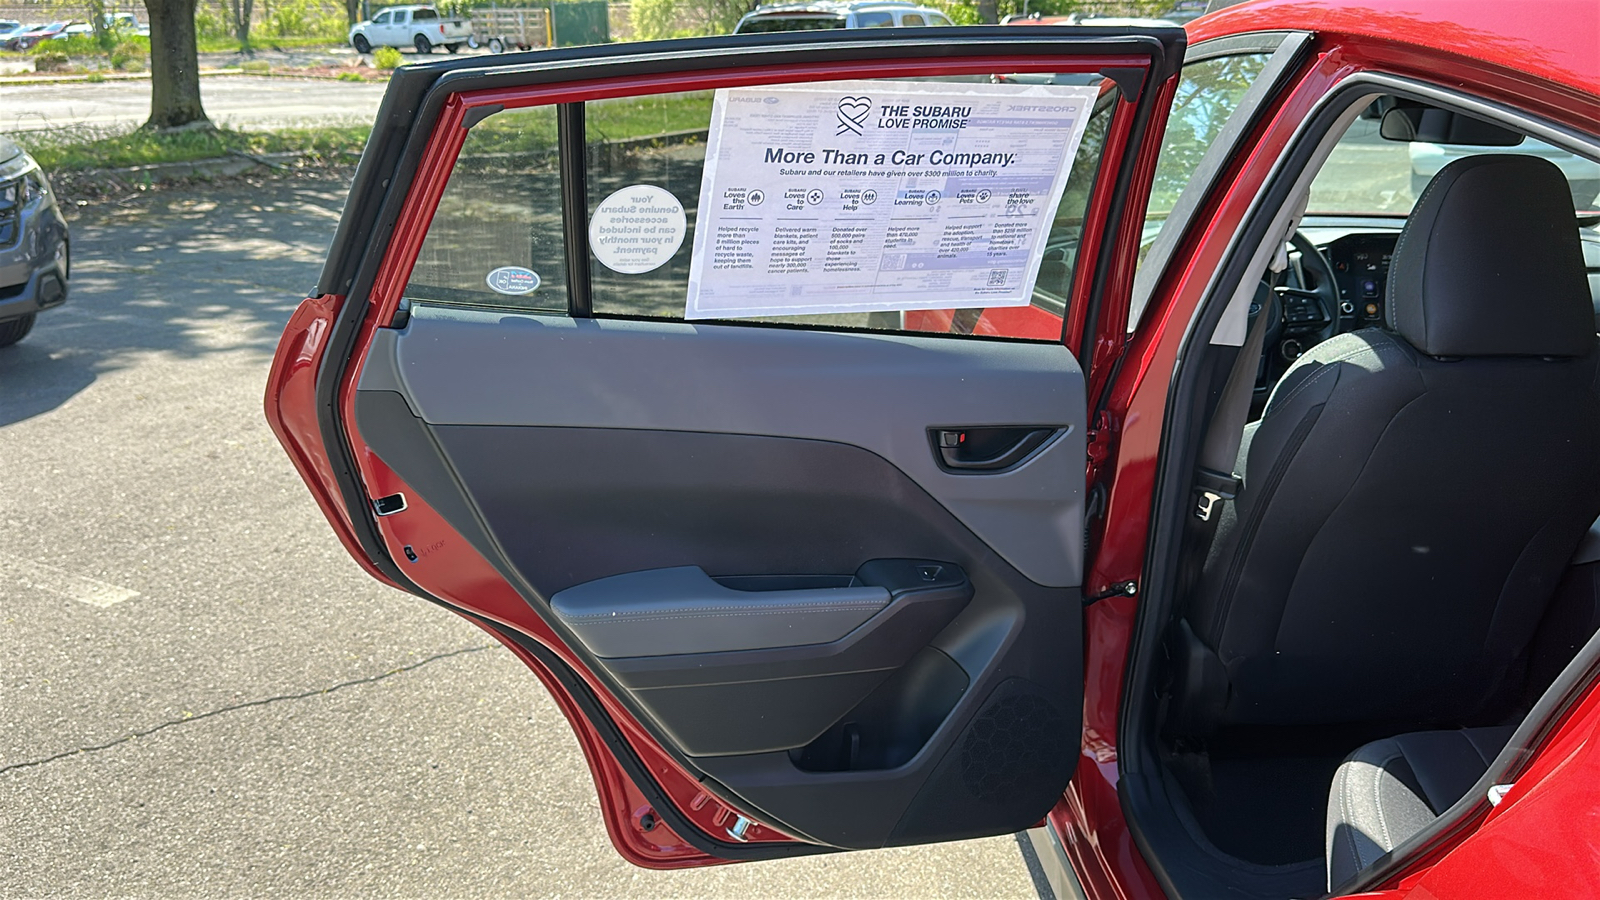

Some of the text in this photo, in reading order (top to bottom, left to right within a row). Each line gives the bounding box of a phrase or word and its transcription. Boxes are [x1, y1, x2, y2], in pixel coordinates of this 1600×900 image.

[881, 105, 972, 118] THE SUBARU
[878, 118, 968, 129] LOVE PROMISE
[764, 148, 815, 164] More
[823, 150, 868, 165] Than
[874, 153, 885, 165] a
[892, 150, 924, 165] Car
[868, 169, 885, 177] have
[886, 169, 906, 178] given
[974, 169, 998, 178] charity.
